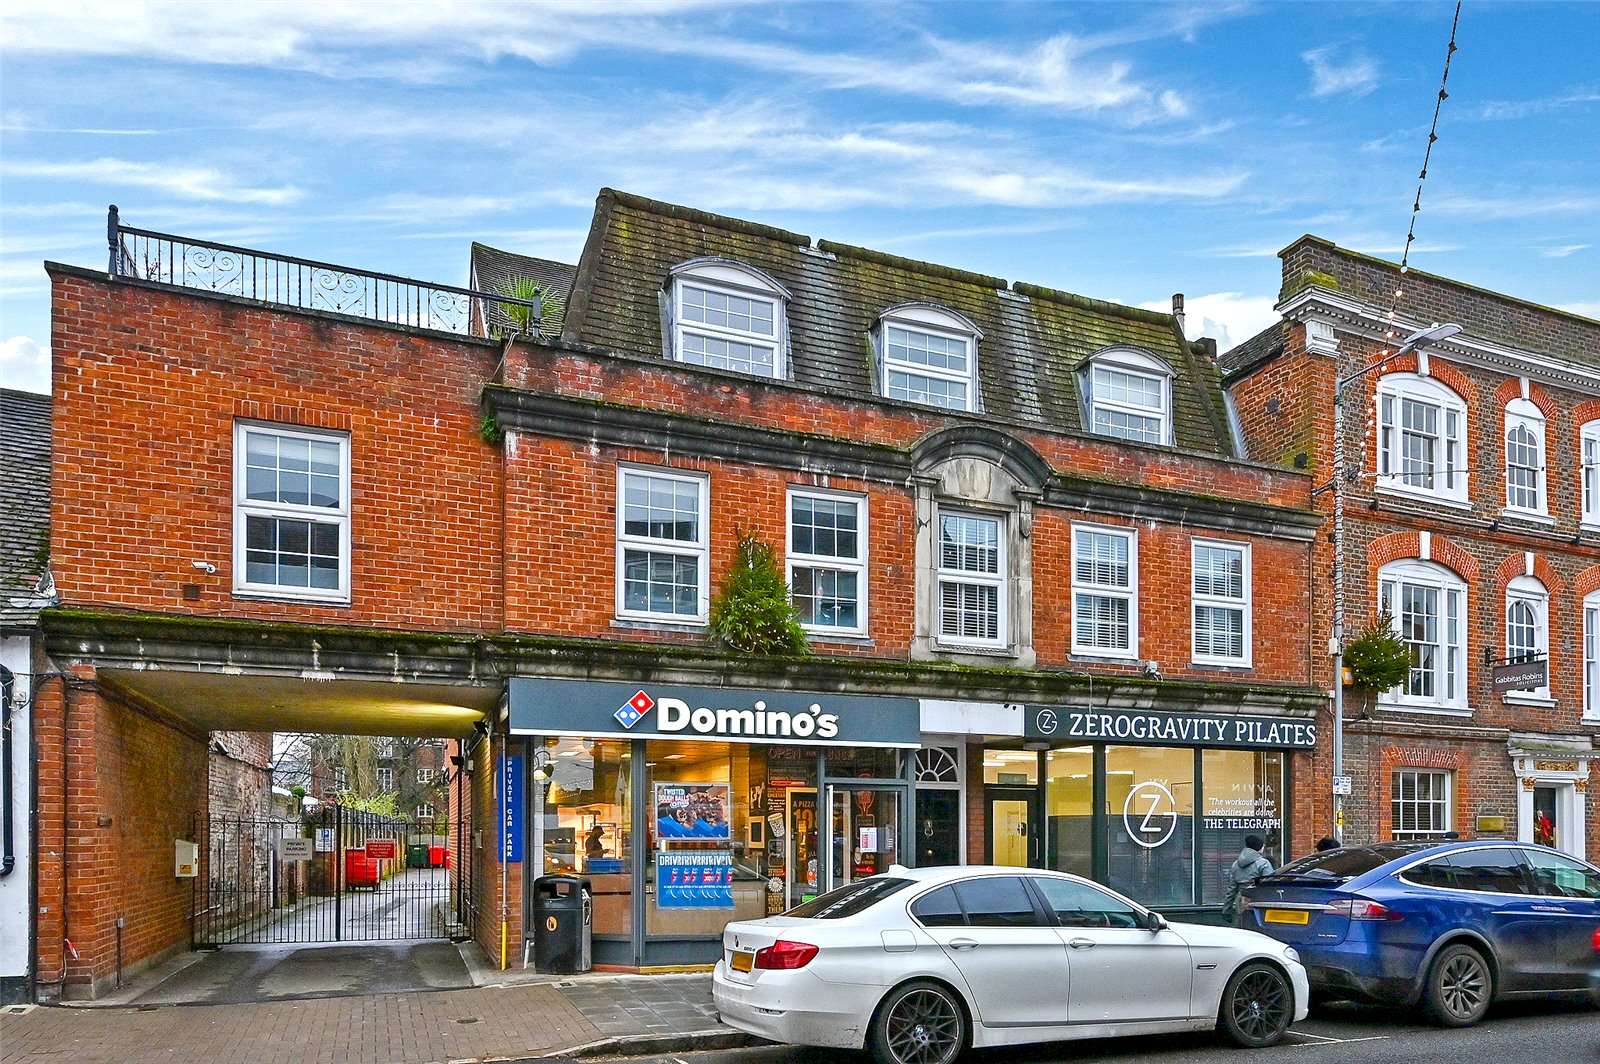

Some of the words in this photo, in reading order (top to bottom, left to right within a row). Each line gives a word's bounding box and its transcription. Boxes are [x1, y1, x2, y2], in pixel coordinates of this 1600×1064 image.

[1522, 672, 1543, 681] Robins
[657, 697, 840, 738] Domino's
[1069, 713, 1229, 741] ZEROGRAVITY
[1235, 720, 1317, 746] PILATES
[1203, 818, 1224, 829] THE
[1225, 818, 1281, 829] TELEGRAPH
